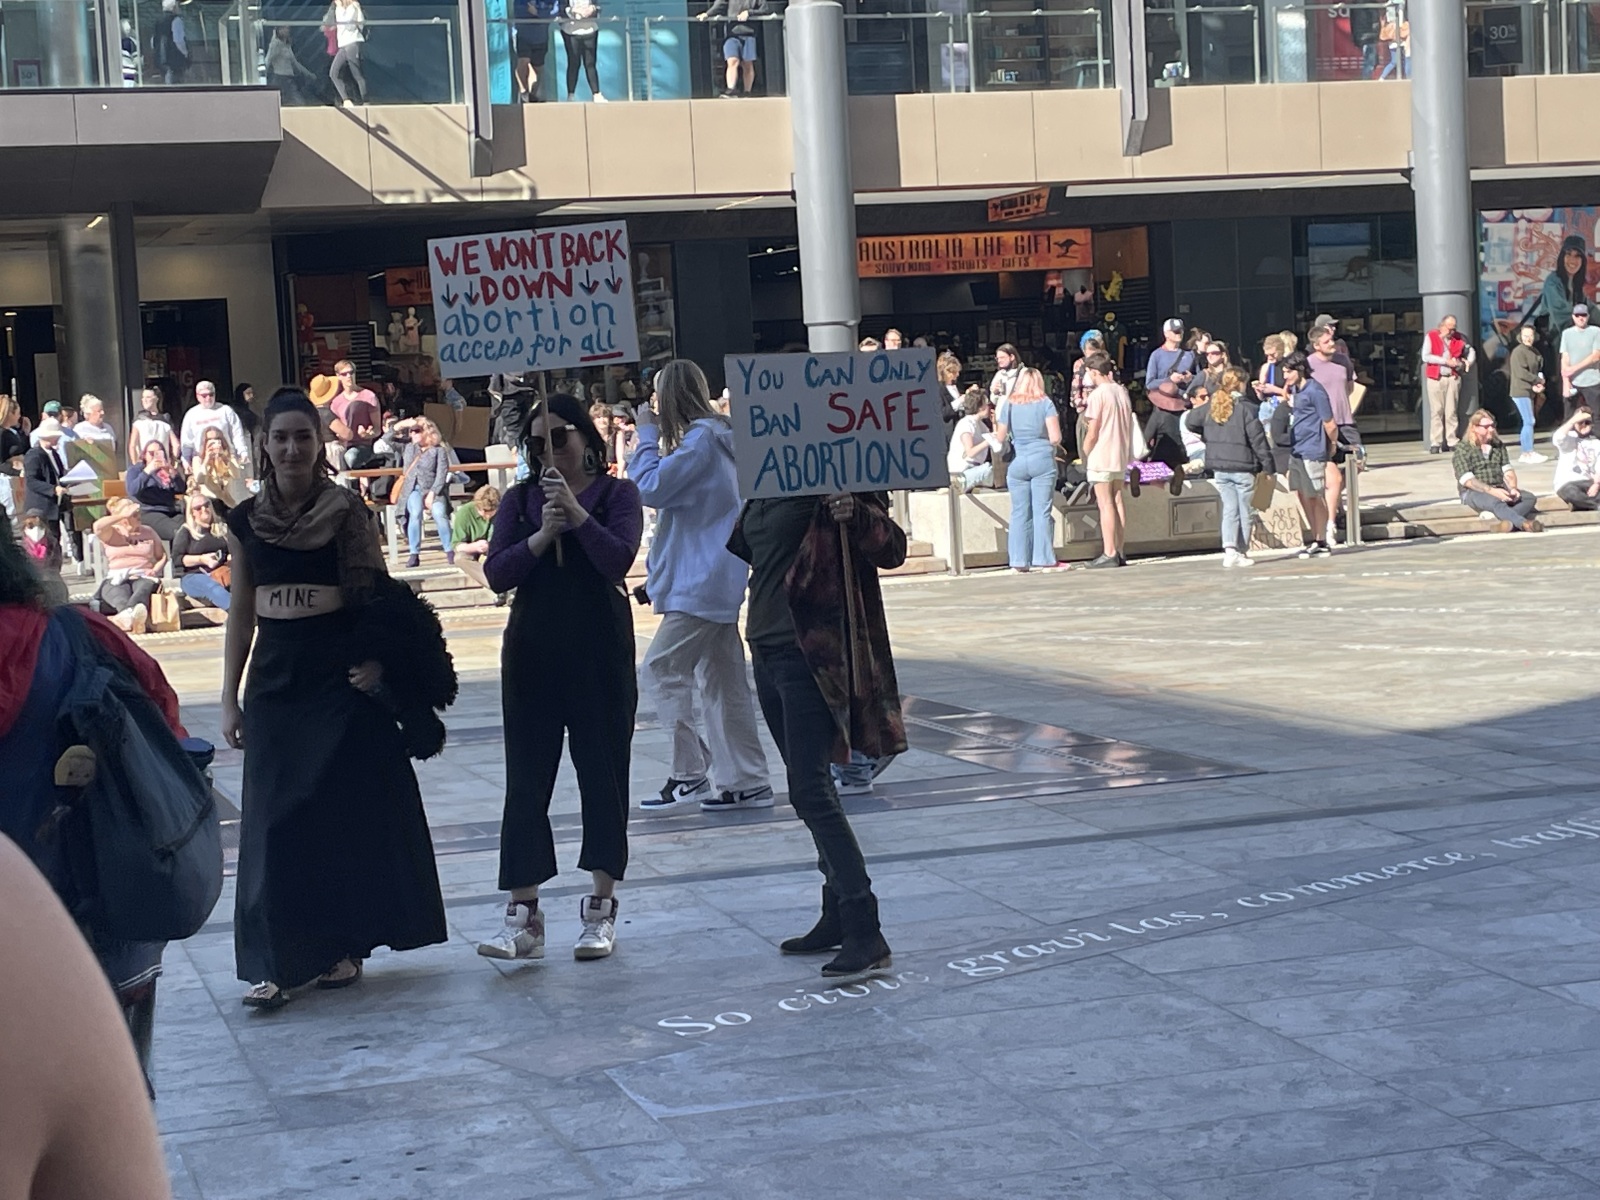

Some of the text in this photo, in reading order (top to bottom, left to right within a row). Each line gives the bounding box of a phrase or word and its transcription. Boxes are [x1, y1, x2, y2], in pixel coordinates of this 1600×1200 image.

[434, 228, 626, 276] WE WON'T BACK
[859, 234, 1051, 262] AUSTRALIA THE GIFT
[1001, 256, 1030, 268] GIFTS
[480, 268, 573, 306] DOWN
[443, 300, 616, 337] abortion
[440, 328, 616, 366] access for all
[804, 356, 854, 388] CAN
[868, 353, 931, 383] ONLY
[750, 389, 929, 438] BAN SAFE
[754, 437, 930, 492] ABORTIONS
[269, 587, 320, 609] MINE
[657, 1011, 752, 1037] So
